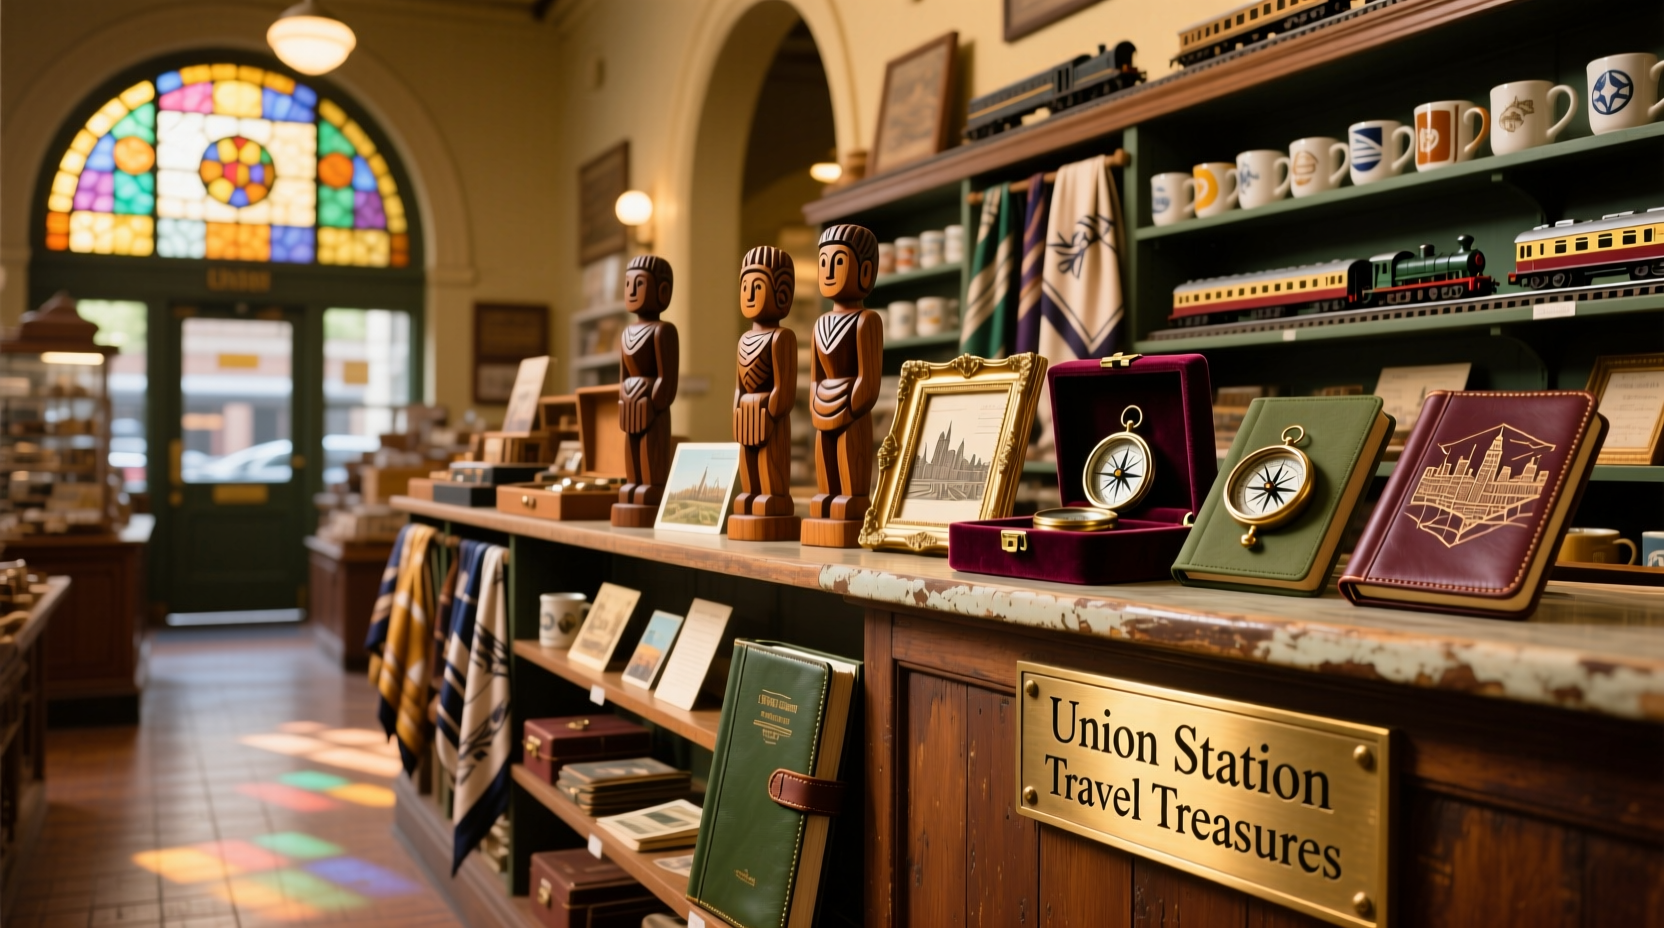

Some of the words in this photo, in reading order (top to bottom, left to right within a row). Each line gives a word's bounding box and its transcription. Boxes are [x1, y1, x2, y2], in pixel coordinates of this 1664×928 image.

[1049, 696, 1160, 767] Union
[1173, 724, 1334, 811] Station
[1044, 753, 1142, 821] Travel
[1151, 783, 1343, 881] Treasures
